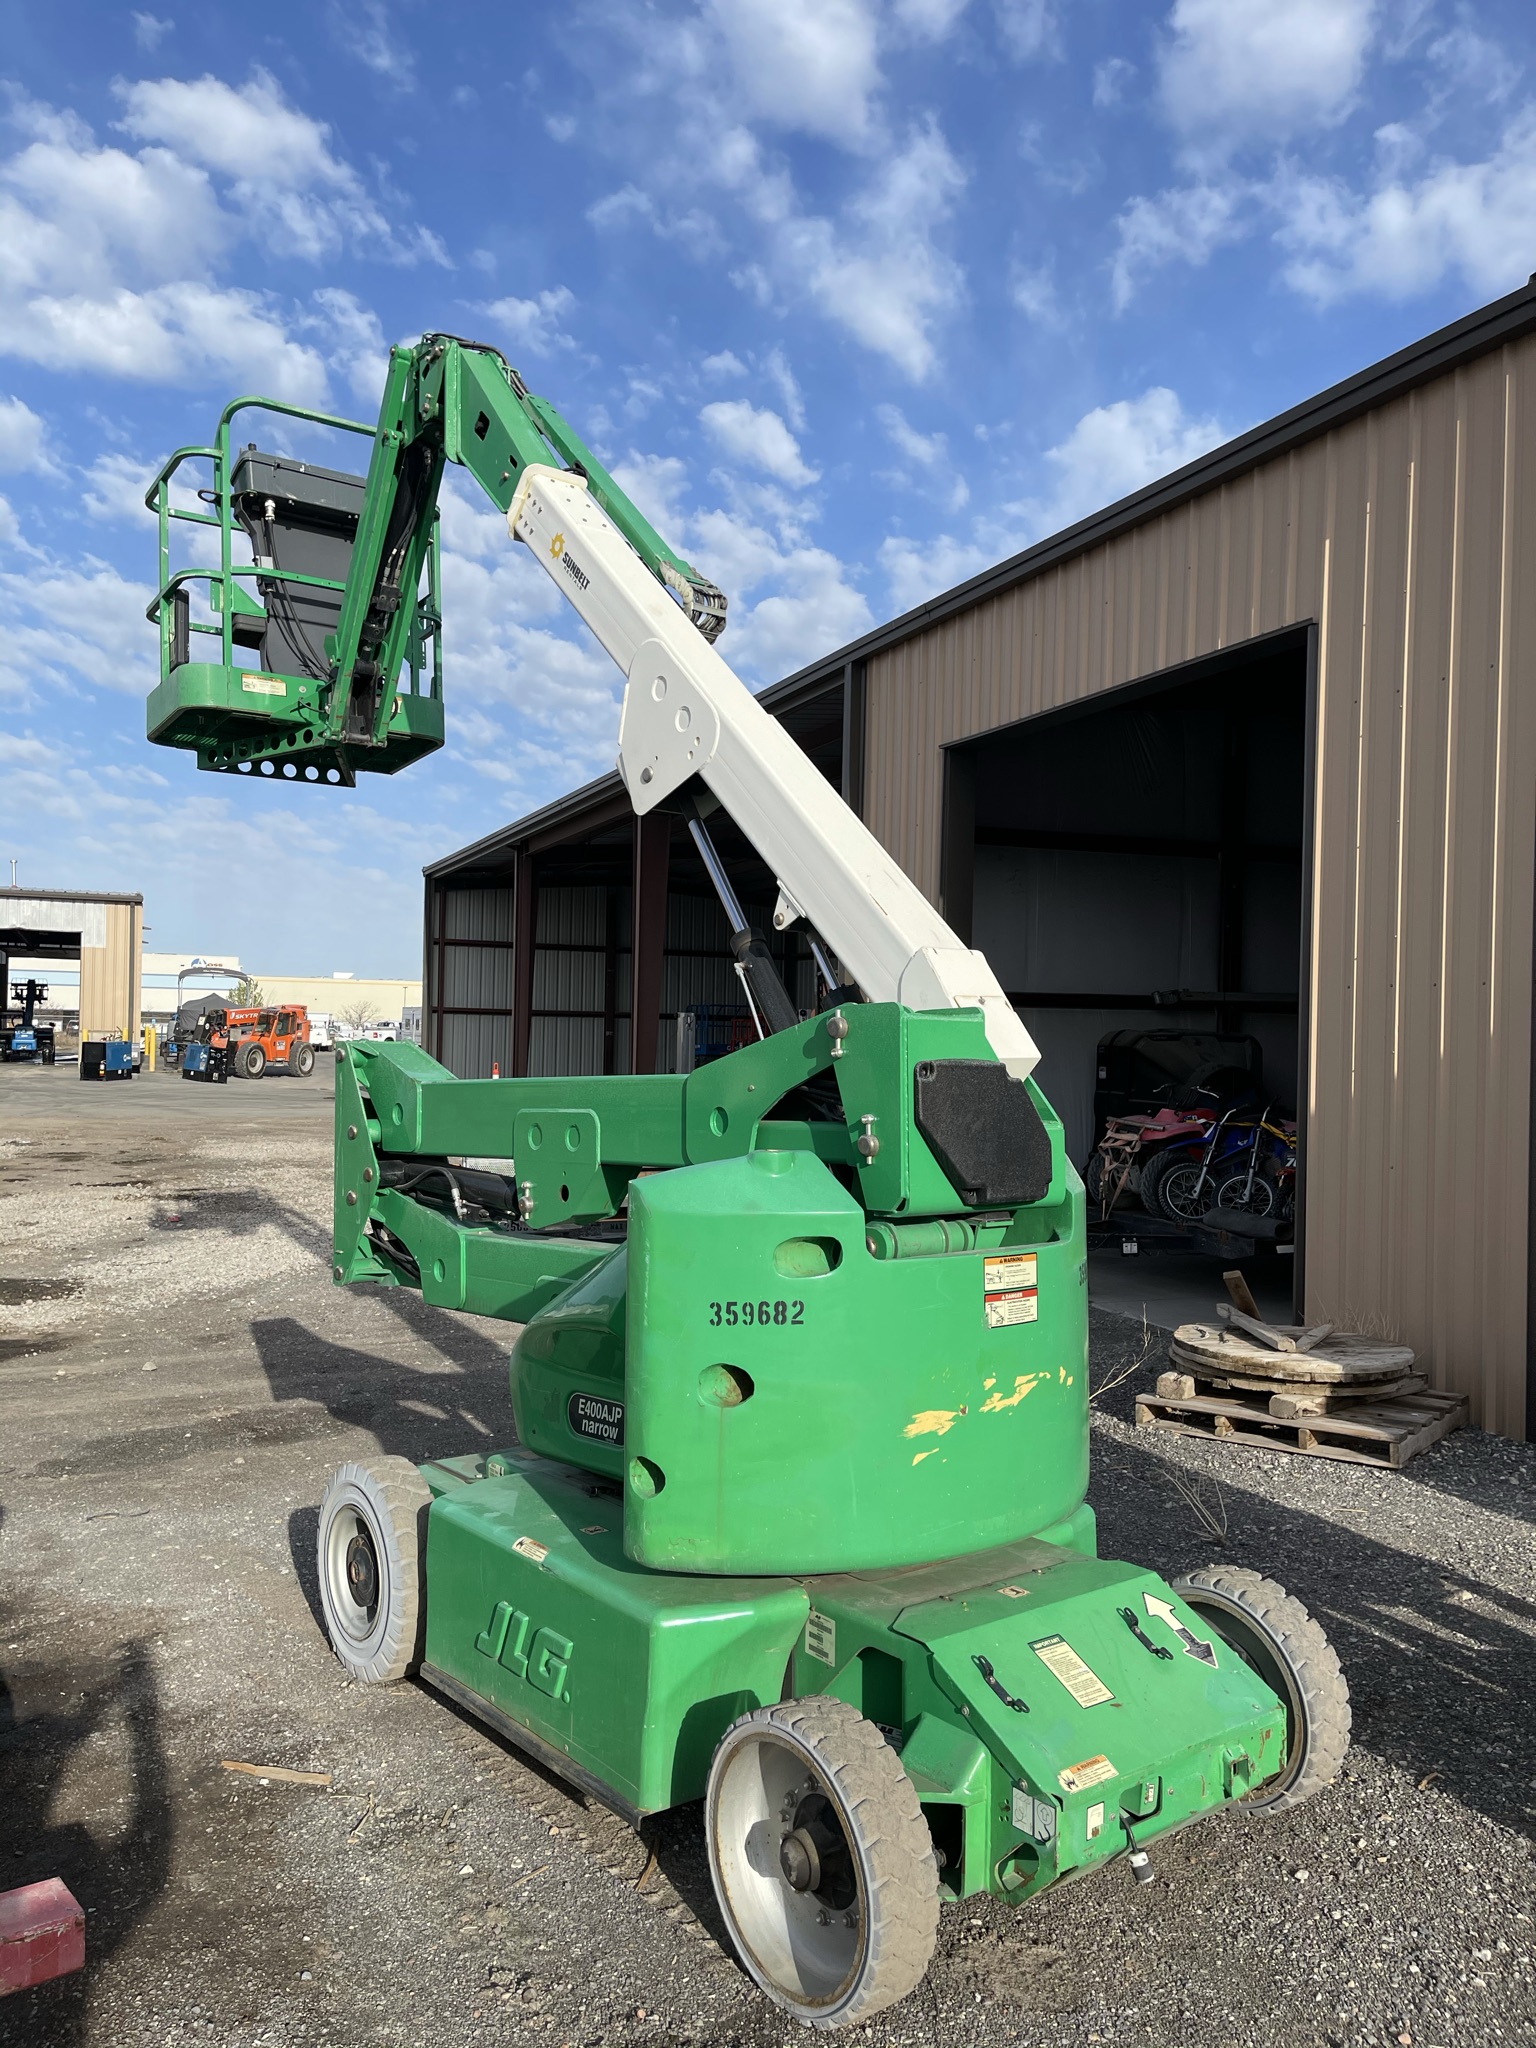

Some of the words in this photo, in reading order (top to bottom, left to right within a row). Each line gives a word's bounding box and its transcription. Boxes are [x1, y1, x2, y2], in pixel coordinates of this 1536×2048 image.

[562, 551, 590, 590] SUNBELT
[1003, 1256, 1023, 1264] WARNING
[1005, 1292, 1023, 1300] DANGER
[709, 1300, 805, 1327] 359682
[578, 1398, 623, 1424] E400AJP
[581, 1418, 619, 1440] narrow
[1032, 1637, 1061, 1650] IMPORTANT
